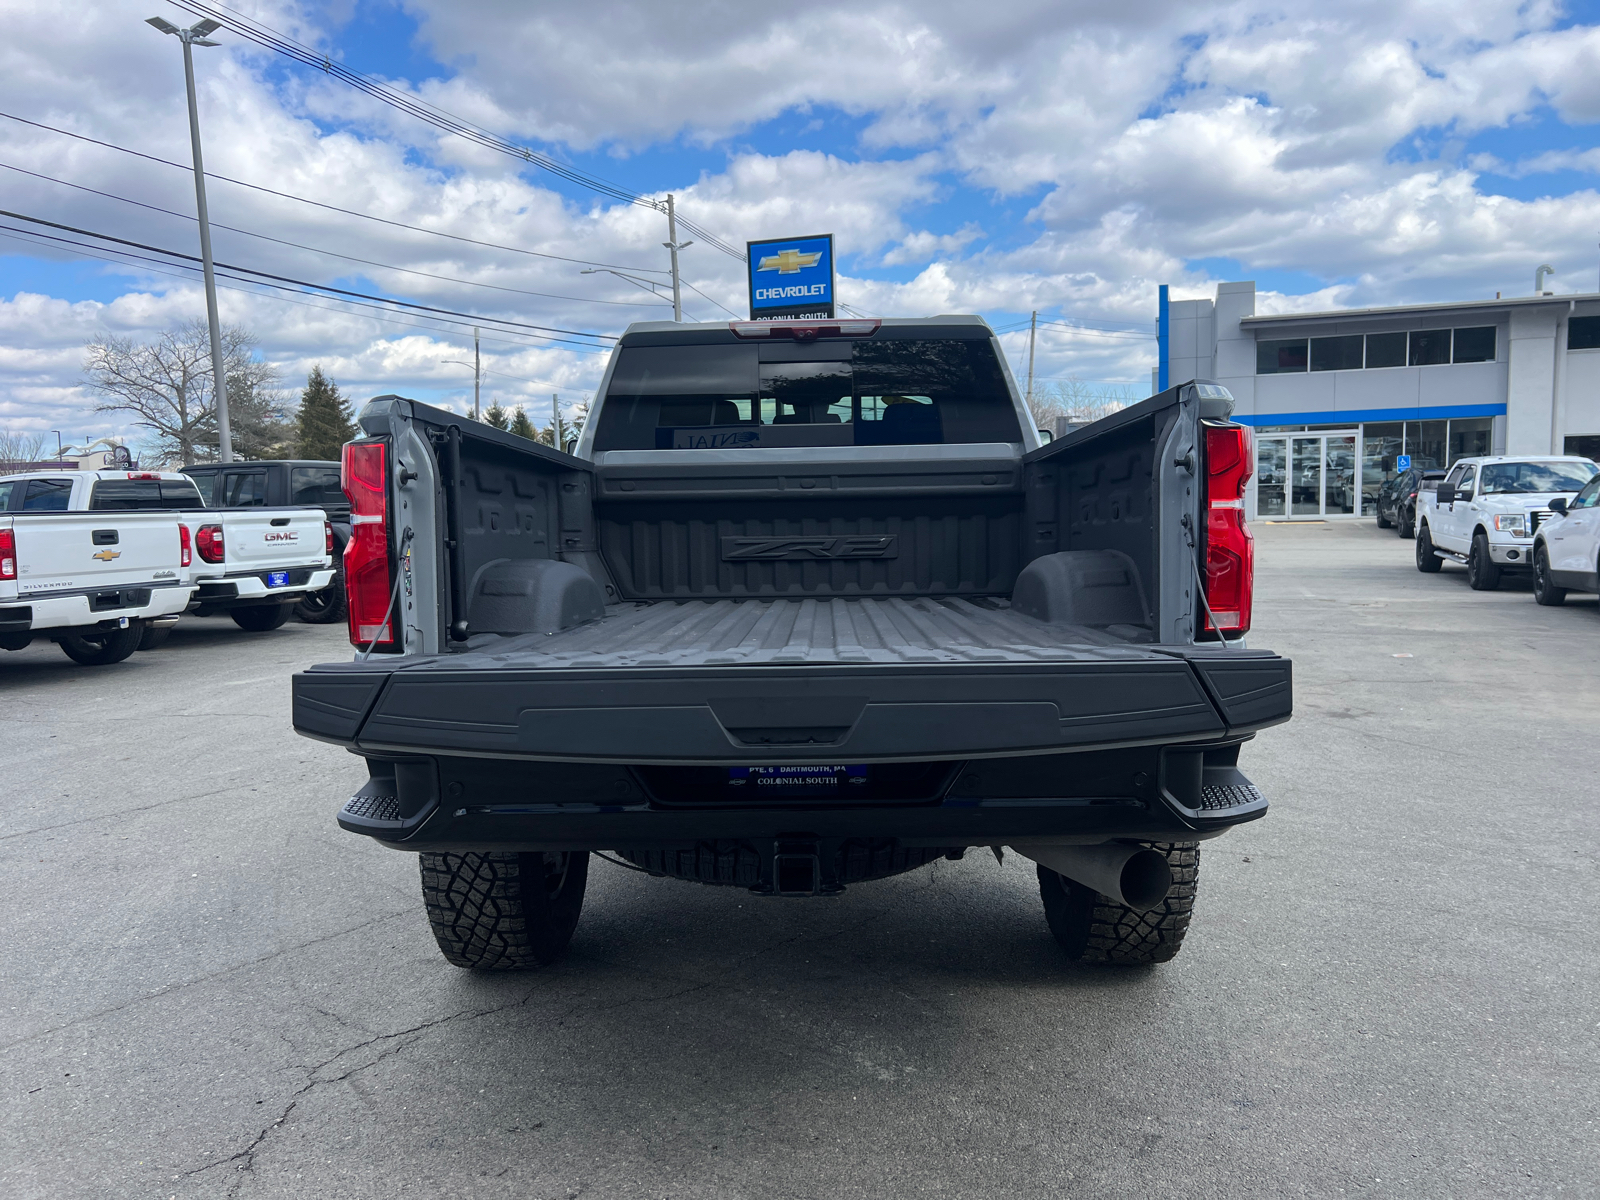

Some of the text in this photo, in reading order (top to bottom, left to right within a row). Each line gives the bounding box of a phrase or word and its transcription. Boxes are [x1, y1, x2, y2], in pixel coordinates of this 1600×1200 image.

[756, 284, 826, 300] CHEVROLET
[800, 312, 828, 320] SOUTH
[264, 532, 298, 541] GMC
[726, 538, 894, 559] ZR2
[23, 581, 73, 590] SILVERADO
[757, 777, 805, 785] COLONIAL
